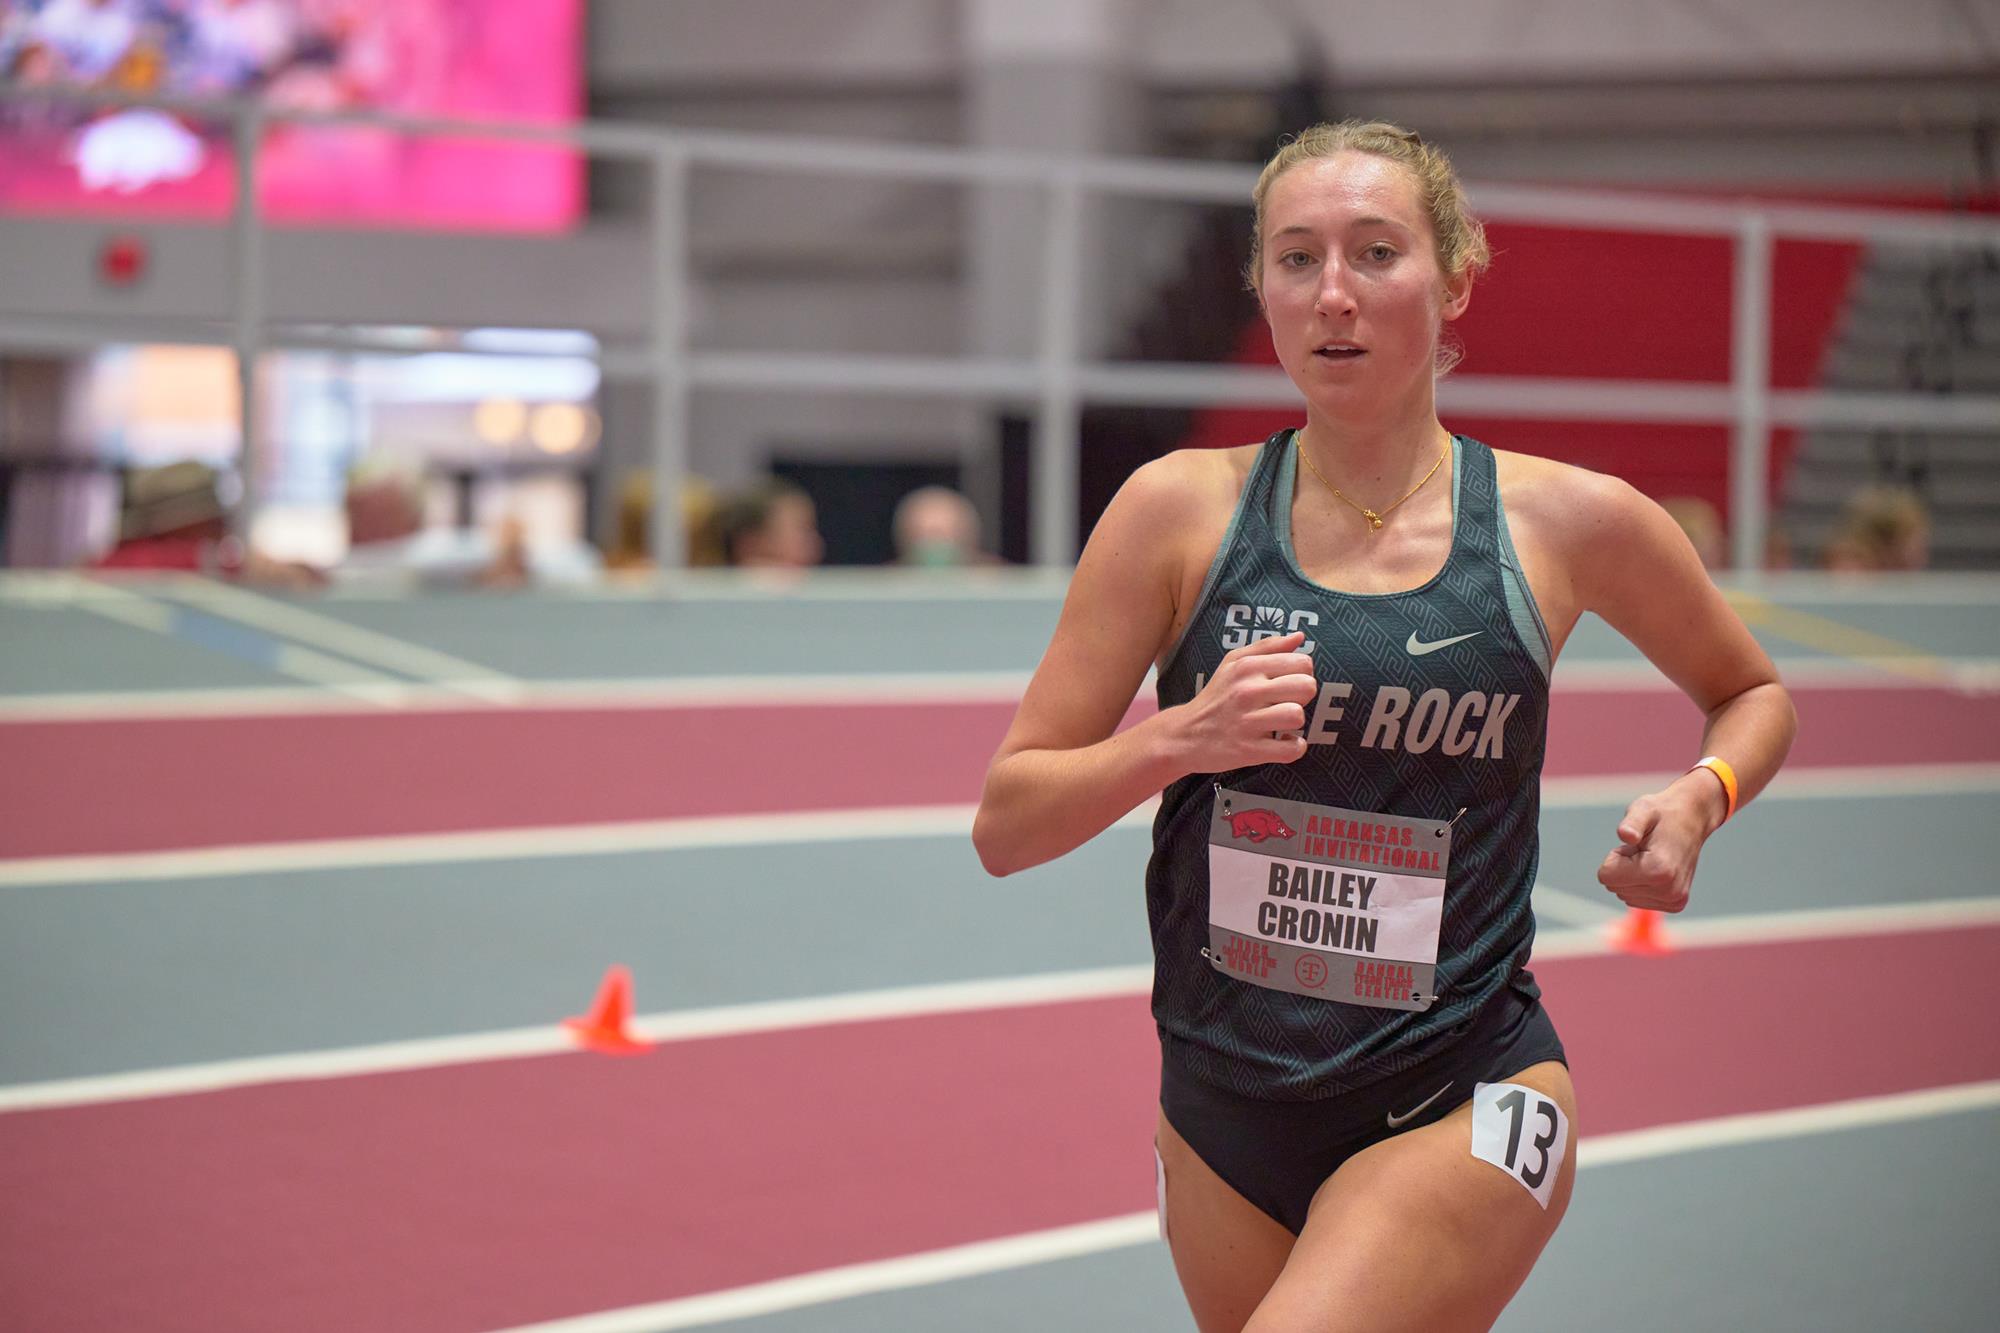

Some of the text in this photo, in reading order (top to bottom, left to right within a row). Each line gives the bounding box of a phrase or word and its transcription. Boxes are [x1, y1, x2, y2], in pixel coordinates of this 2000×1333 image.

[1360, 685, 1521, 760] ROCK
[1304, 836, 1441, 871] INVITATIONAL
[1306, 815, 1415, 847] ARKANSAS
[1267, 862, 1378, 911] BAILEY
[1257, 901, 1379, 953] CRONIN
[1495, 1089, 1558, 1189] 13
